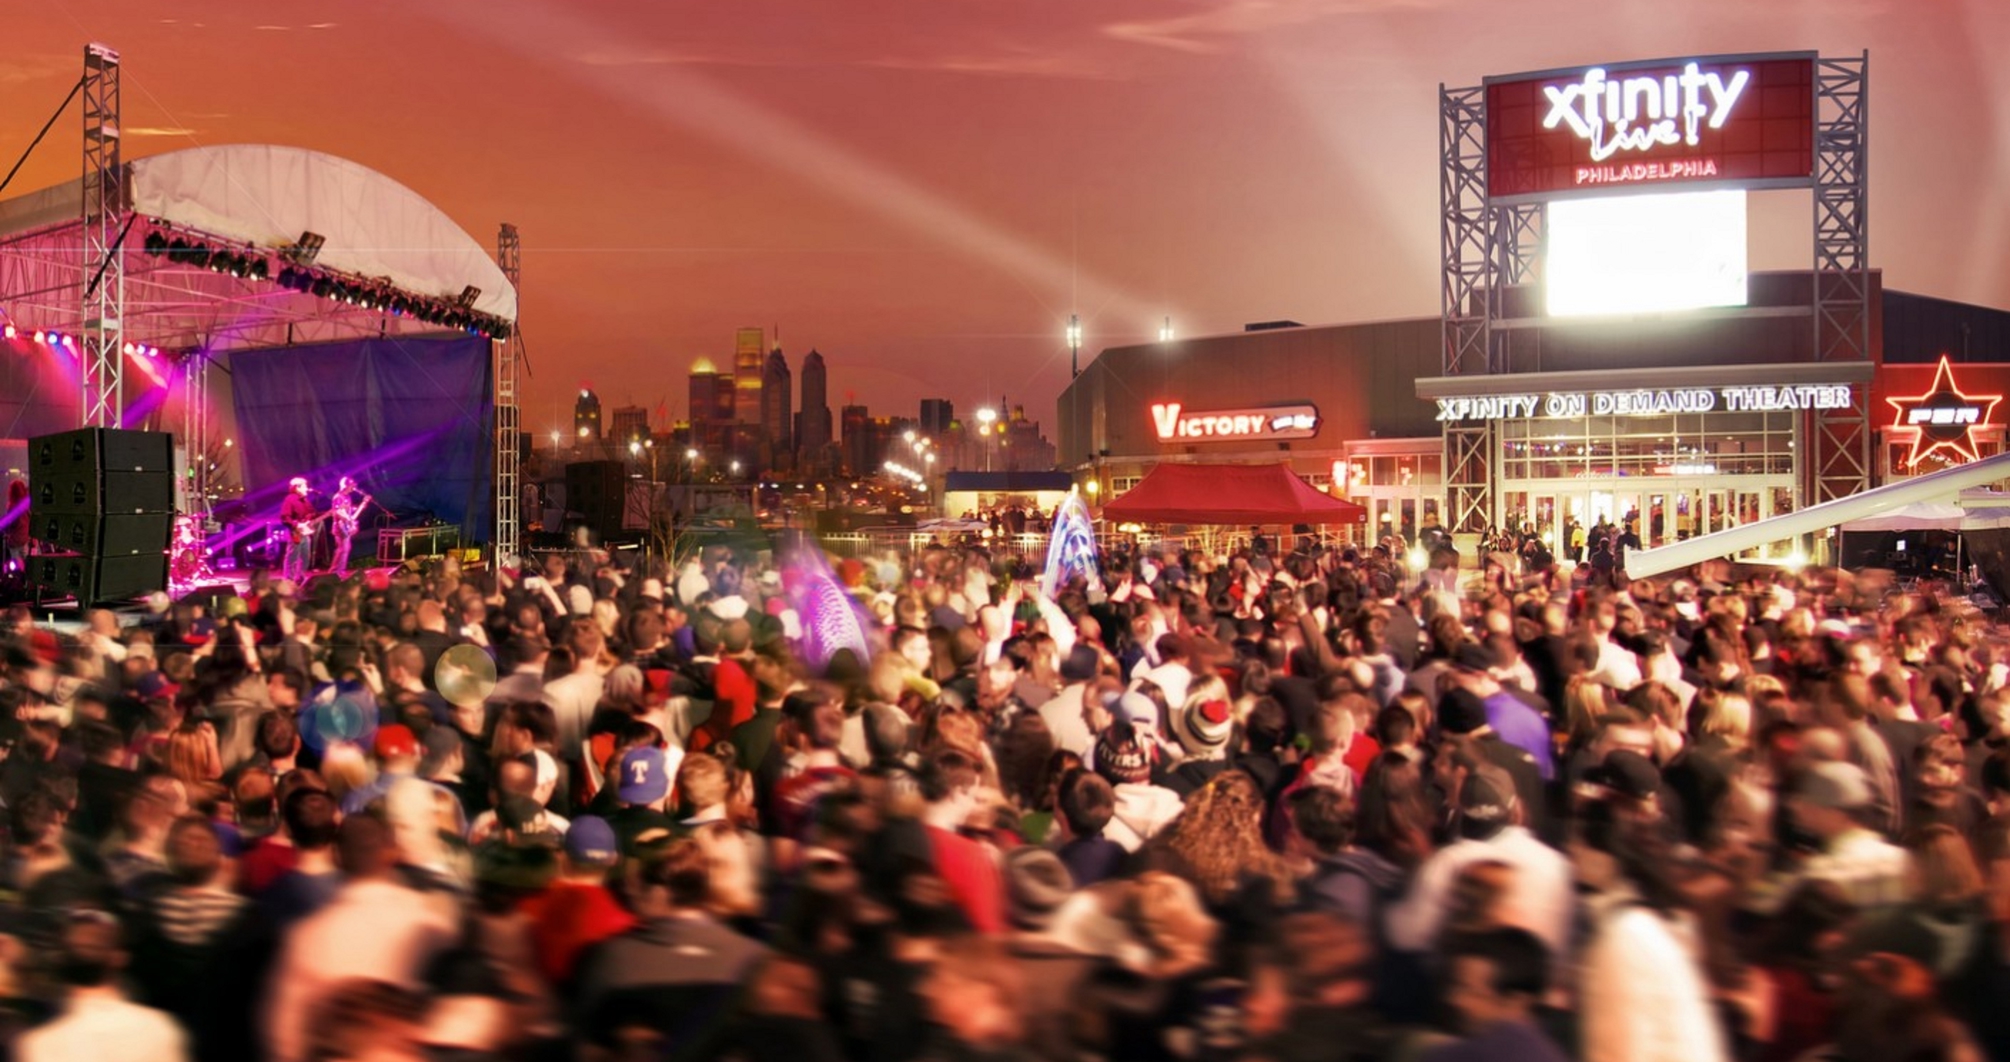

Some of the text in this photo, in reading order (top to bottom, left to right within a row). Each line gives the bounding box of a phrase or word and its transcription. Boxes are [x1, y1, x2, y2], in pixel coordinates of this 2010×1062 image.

[1542, 62, 1749, 138] xfinity
[1576, 160, 1717, 184] PHILADELPHIA
[1436, 385, 1851, 421] XFINITY ON DEMAND THEATER
[631, 760, 648, 783] T
